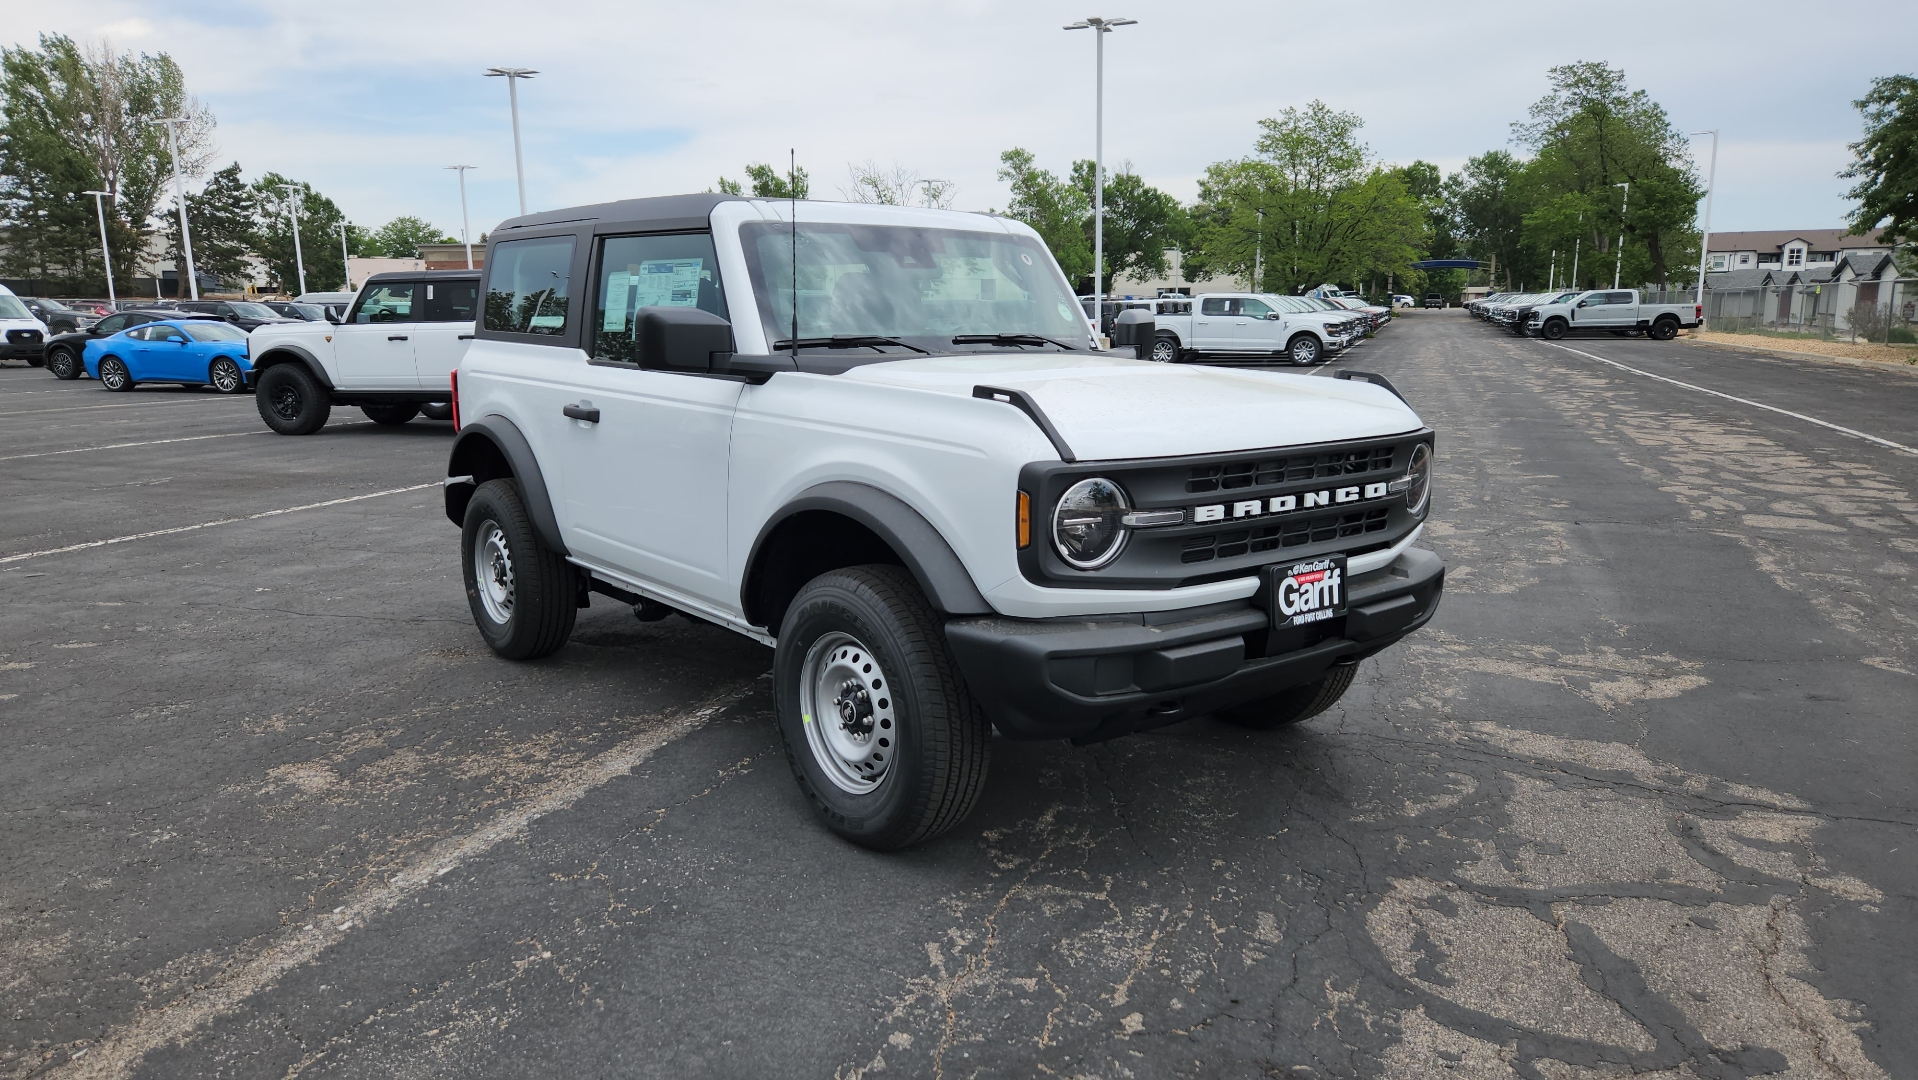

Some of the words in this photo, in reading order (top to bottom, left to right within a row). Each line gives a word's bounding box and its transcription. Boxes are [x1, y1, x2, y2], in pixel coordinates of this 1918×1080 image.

[1194, 482, 1387, 523] BRONCO
[1300, 563, 1313, 574] Ken
[1313, 559, 1330, 572] Garff
[1279, 568, 1340, 616] Garff
[1293, 615, 1304, 626] FORD
[1316, 608, 1333, 620] COLLINS
